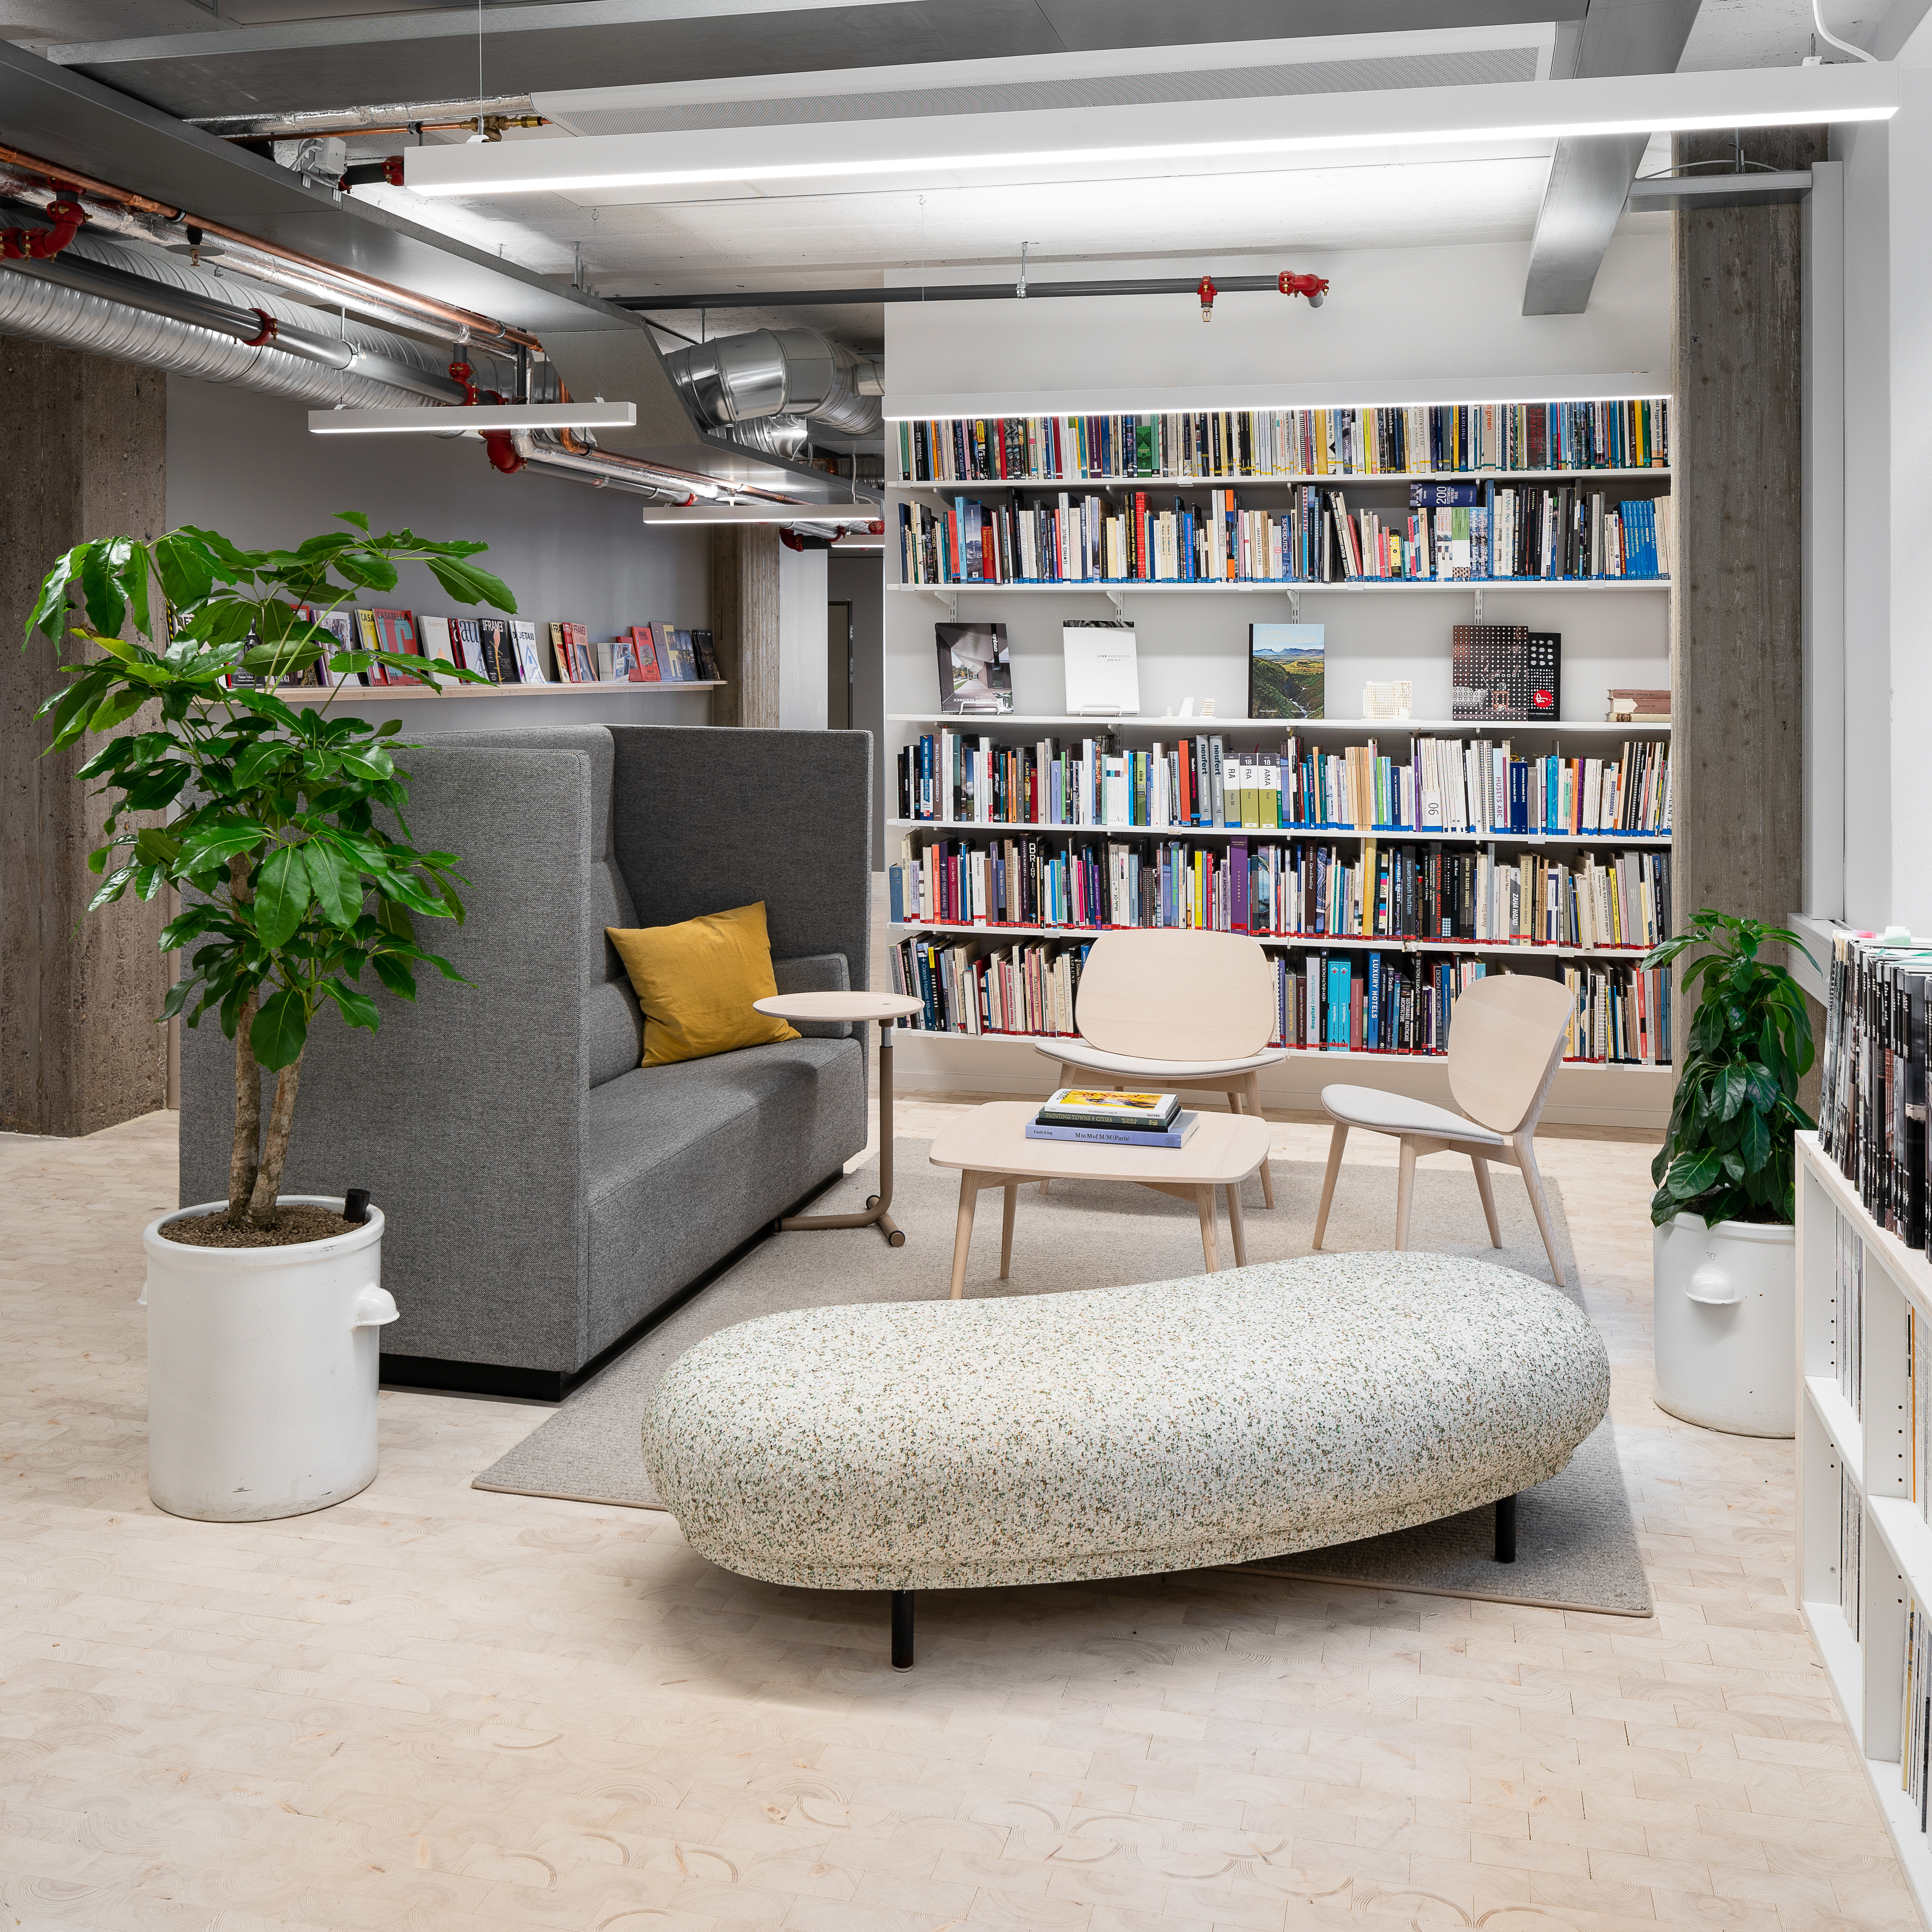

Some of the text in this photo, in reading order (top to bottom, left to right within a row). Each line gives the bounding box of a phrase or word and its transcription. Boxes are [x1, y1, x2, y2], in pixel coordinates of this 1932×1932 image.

[1436, 487, 1446, 504] 200
[1109, 539, 1113, 547] om
[377, 611, 410, 621] CASABELLA
[483, 620, 503, 632] FRAME
[573, 624, 585, 635] FRAME
[519, 632, 535, 640] DETAIL
[390, 673, 399, 681] 918
[1228, 769, 1235, 778] RA
[1246, 769, 1251, 779] RA
[1429, 803, 1438, 815] 90
